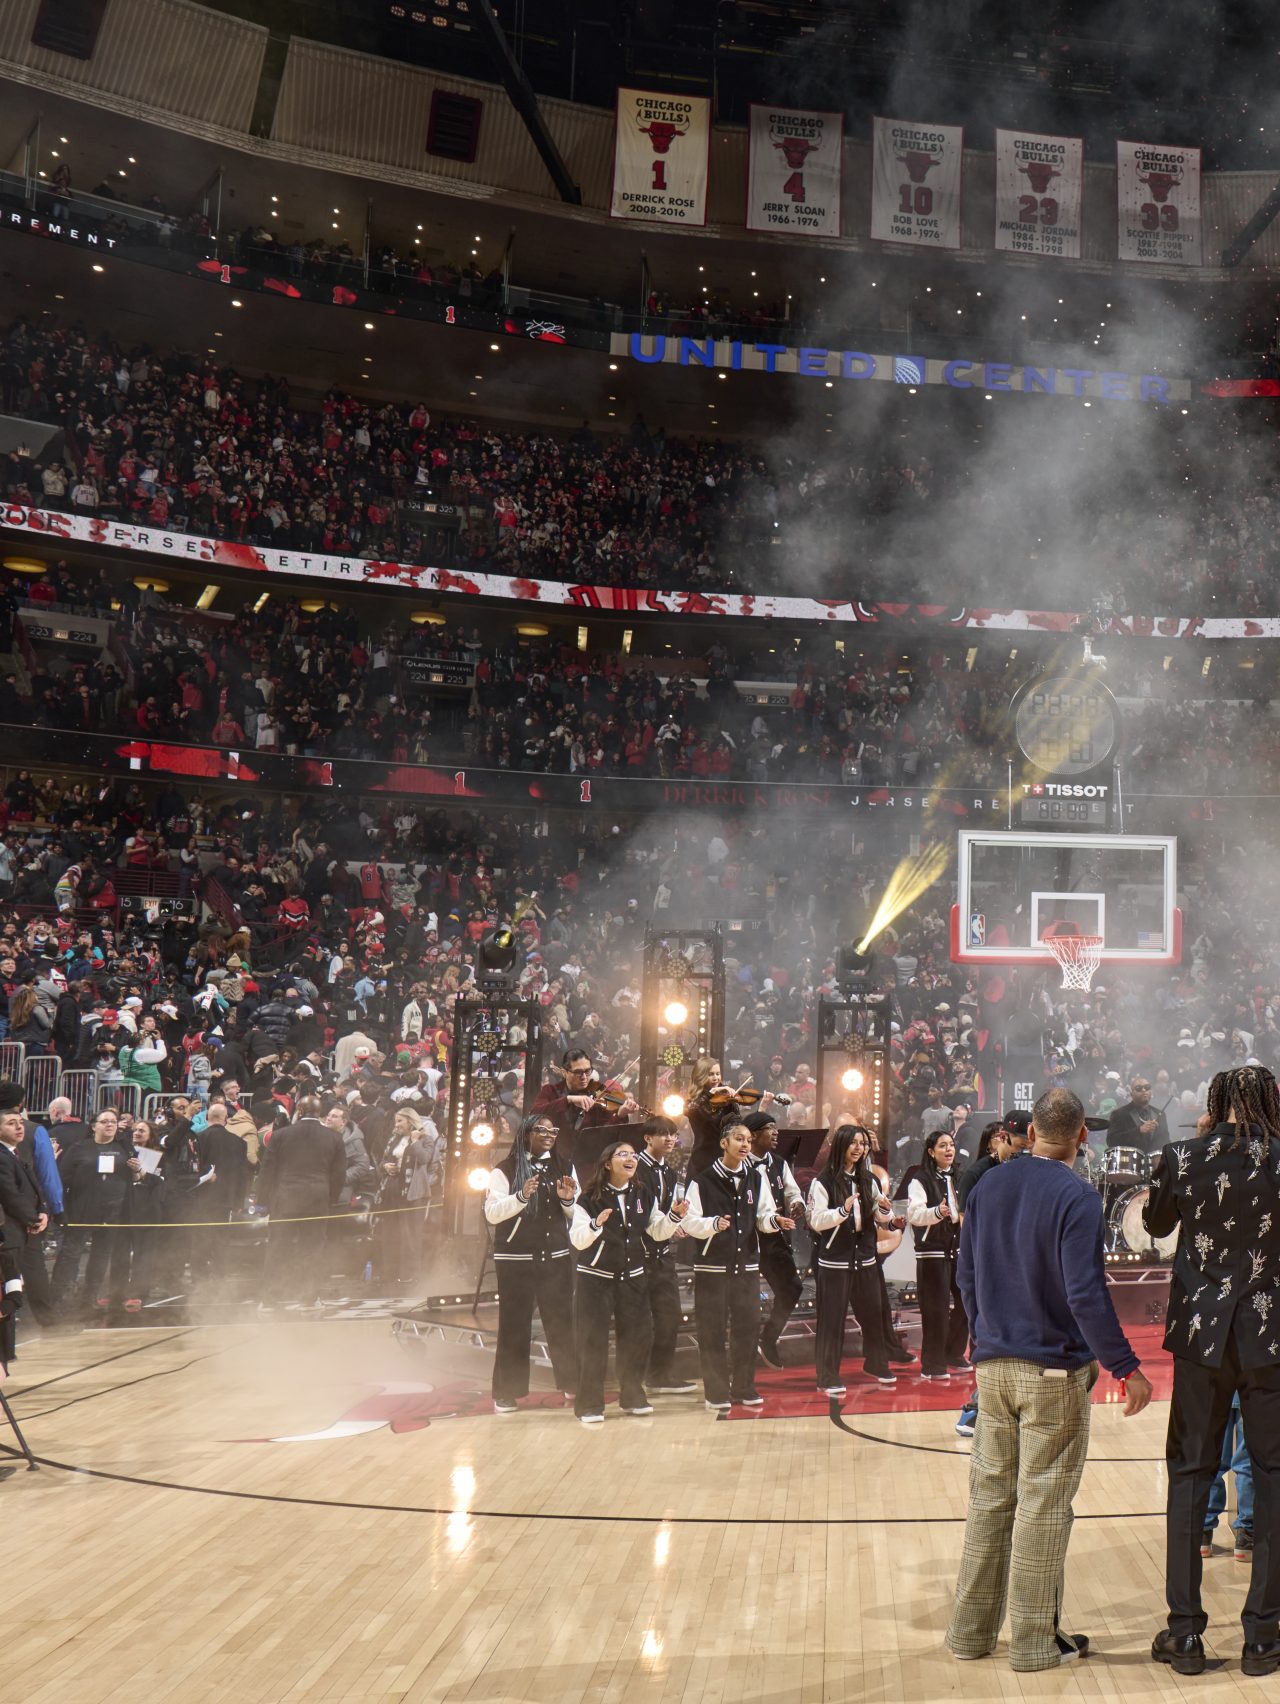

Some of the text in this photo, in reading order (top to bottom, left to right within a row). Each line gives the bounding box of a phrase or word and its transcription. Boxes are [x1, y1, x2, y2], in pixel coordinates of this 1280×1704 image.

[635, 97, 692, 113] CHICAGO
[644, 110, 684, 123] BULLS
[769, 114, 824, 128] CHICAGO
[777, 125, 816, 138] BULLS
[892, 128, 945, 142] CHICAGO
[900, 140, 938, 152] BULLS
[1014, 140, 1065, 154] CHICAGO
[1021, 151, 1058, 163] BULLS
[1134, 150, 1184, 164] CHICAGO
[652, 161, 667, 190] 1
[1143, 162, 1178, 173] BULLS
[784, 172, 806, 203] 4
[622, 192, 695, 208] DERRICK ROSE
[899, 184, 933, 215] 10
[630, 204, 686, 217] 2008-2016
[763, 203, 825, 216] JERRY SLOAN
[1018, 195, 1058, 225] 23
[1141, 203, 1179, 232] 33
[893, 215, 938, 228] BOB LOVE
[1000, 221, 1078, 238] MICHAEL JORDAN
[1127, 229, 1194, 243] SCOTTIE PIPPEN
[220, 264, 231, 283] 1
[446, 306, 455, 324] 1
[630, 332, 1170, 403] UNITED CENTER
[90, 525, 219, 556] JERSEY
[320, 762, 333, 785] 1
[455, 771, 465, 794] 1
[1045, 783, 1108, 798] TISSOT
[580, 780, 591, 802] 1
[1014, 1083, 1034, 1100] GET
